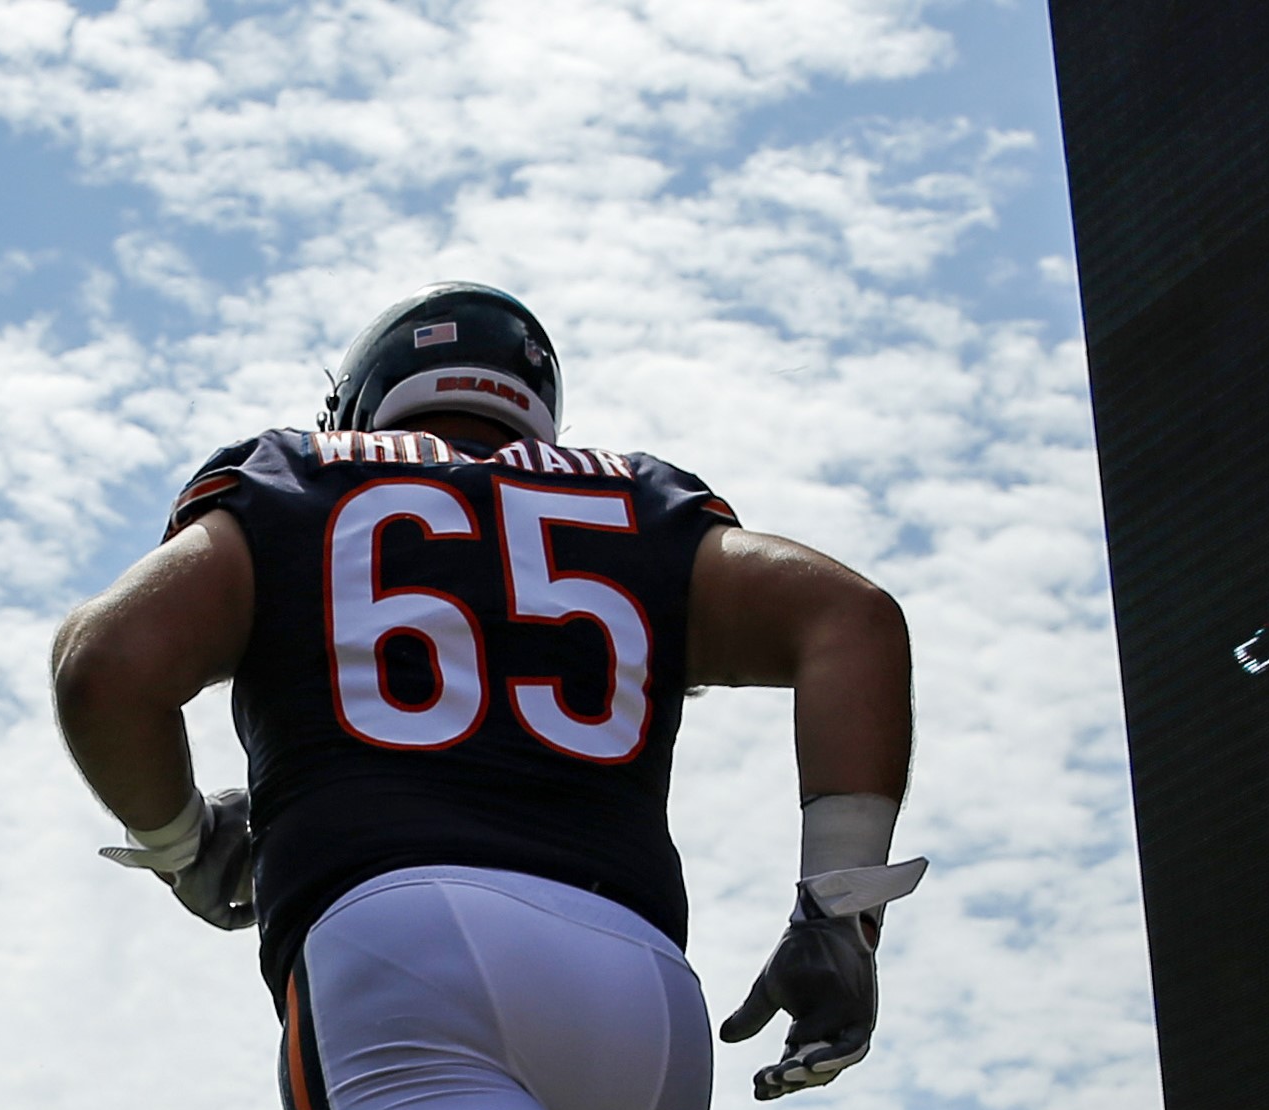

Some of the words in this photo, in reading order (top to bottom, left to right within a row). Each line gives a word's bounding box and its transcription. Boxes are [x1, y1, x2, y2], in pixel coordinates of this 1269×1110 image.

[435, 376, 530, 411] BEARS
[312, 430, 635, 480] WHITHAIR
[324, 475, 653, 765] 65
